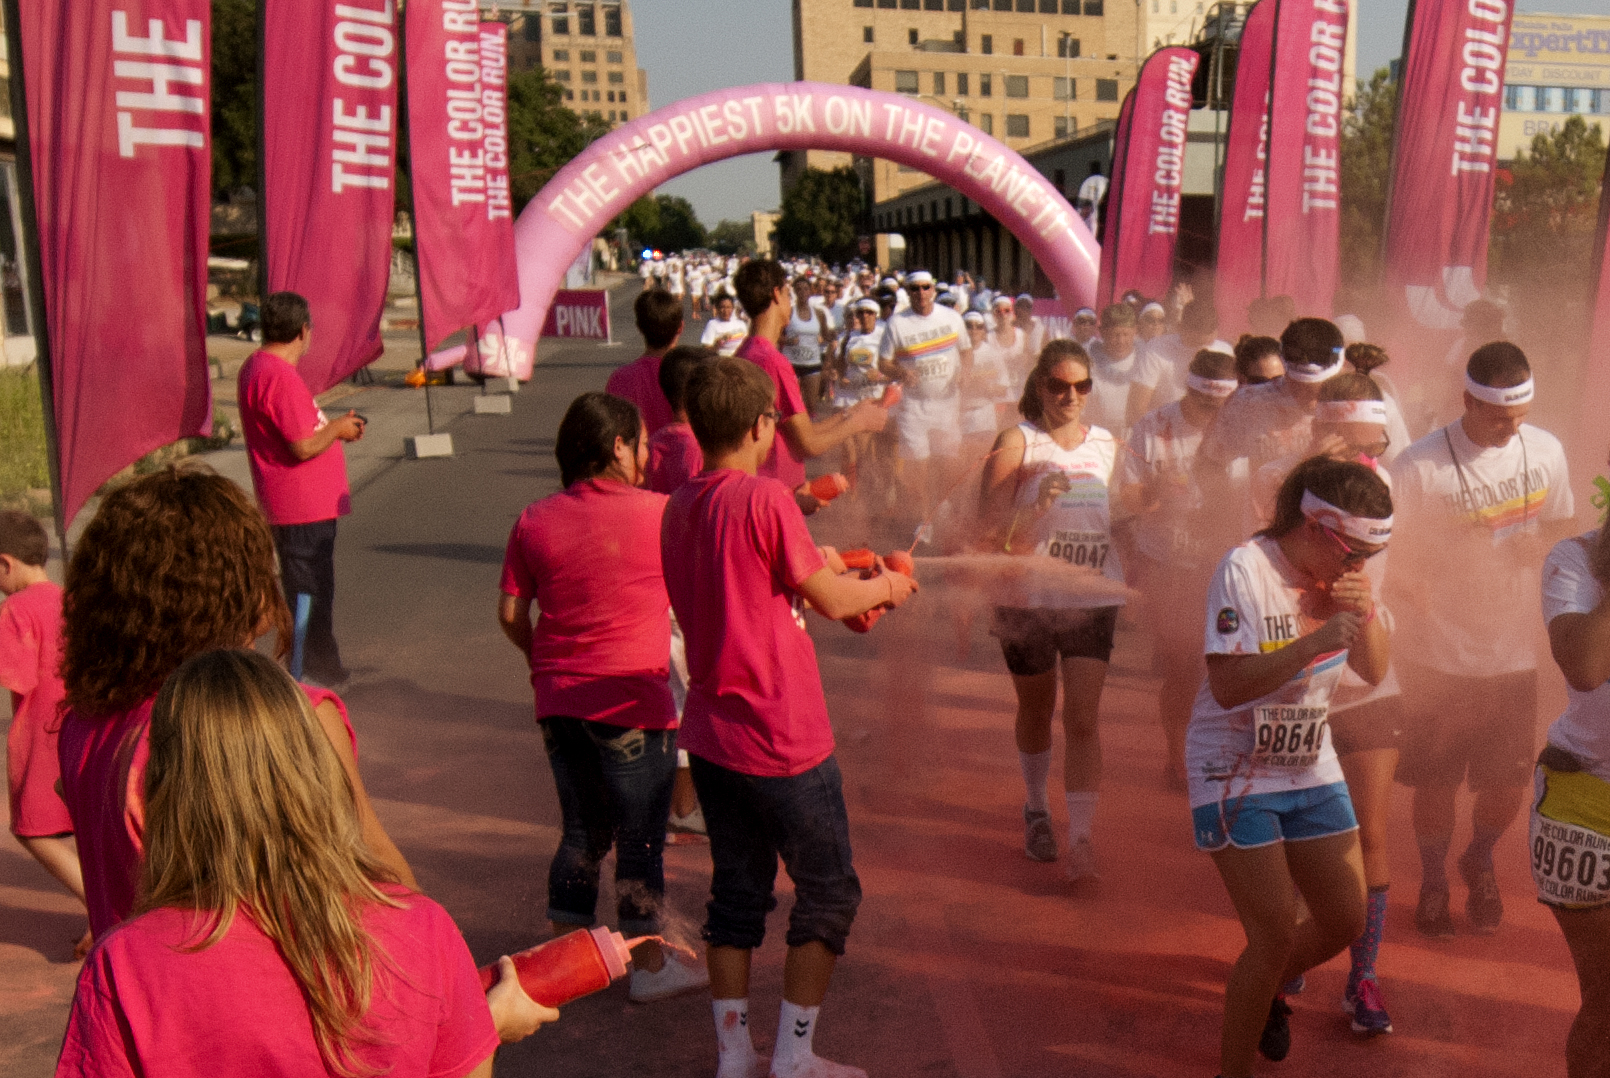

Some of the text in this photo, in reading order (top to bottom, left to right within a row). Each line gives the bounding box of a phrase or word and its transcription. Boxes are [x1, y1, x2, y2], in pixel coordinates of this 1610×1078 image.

[111, 10, 204, 158] THE
[445, 39, 484, 141] COLOR
[1305, 20, 1344, 138] COLOR
[331, 97, 391, 194] THE
[481, 89, 507, 169] COLOR
[548, 161, 620, 229] THE
[608, 96, 764, 186] HAPPIEST
[774, 94, 816, 134] 5K
[824, 95, 872, 138] ON
[882, 102, 946, 157] THE
[1154, 108, 1187, 187] COLOR
[1451, 100, 1496, 177] THE
[450, 147, 486, 207] THE
[486, 173, 510, 221] THE
[1302, 145, 1338, 215] THE
[1149, 190, 1180, 235] THE
[555, 305, 603, 338] PINK
[1471, 476, 1520, 508] COLOR
[1521, 466, 1548, 496] RUN
[1264, 614, 1296, 641] THE
[1262, 708, 1280, 721] THE
[1280, 707, 1309, 721] COLOR
[1551, 824, 1585, 847] COLOR
[1585, 833, 1608, 851] RUN
